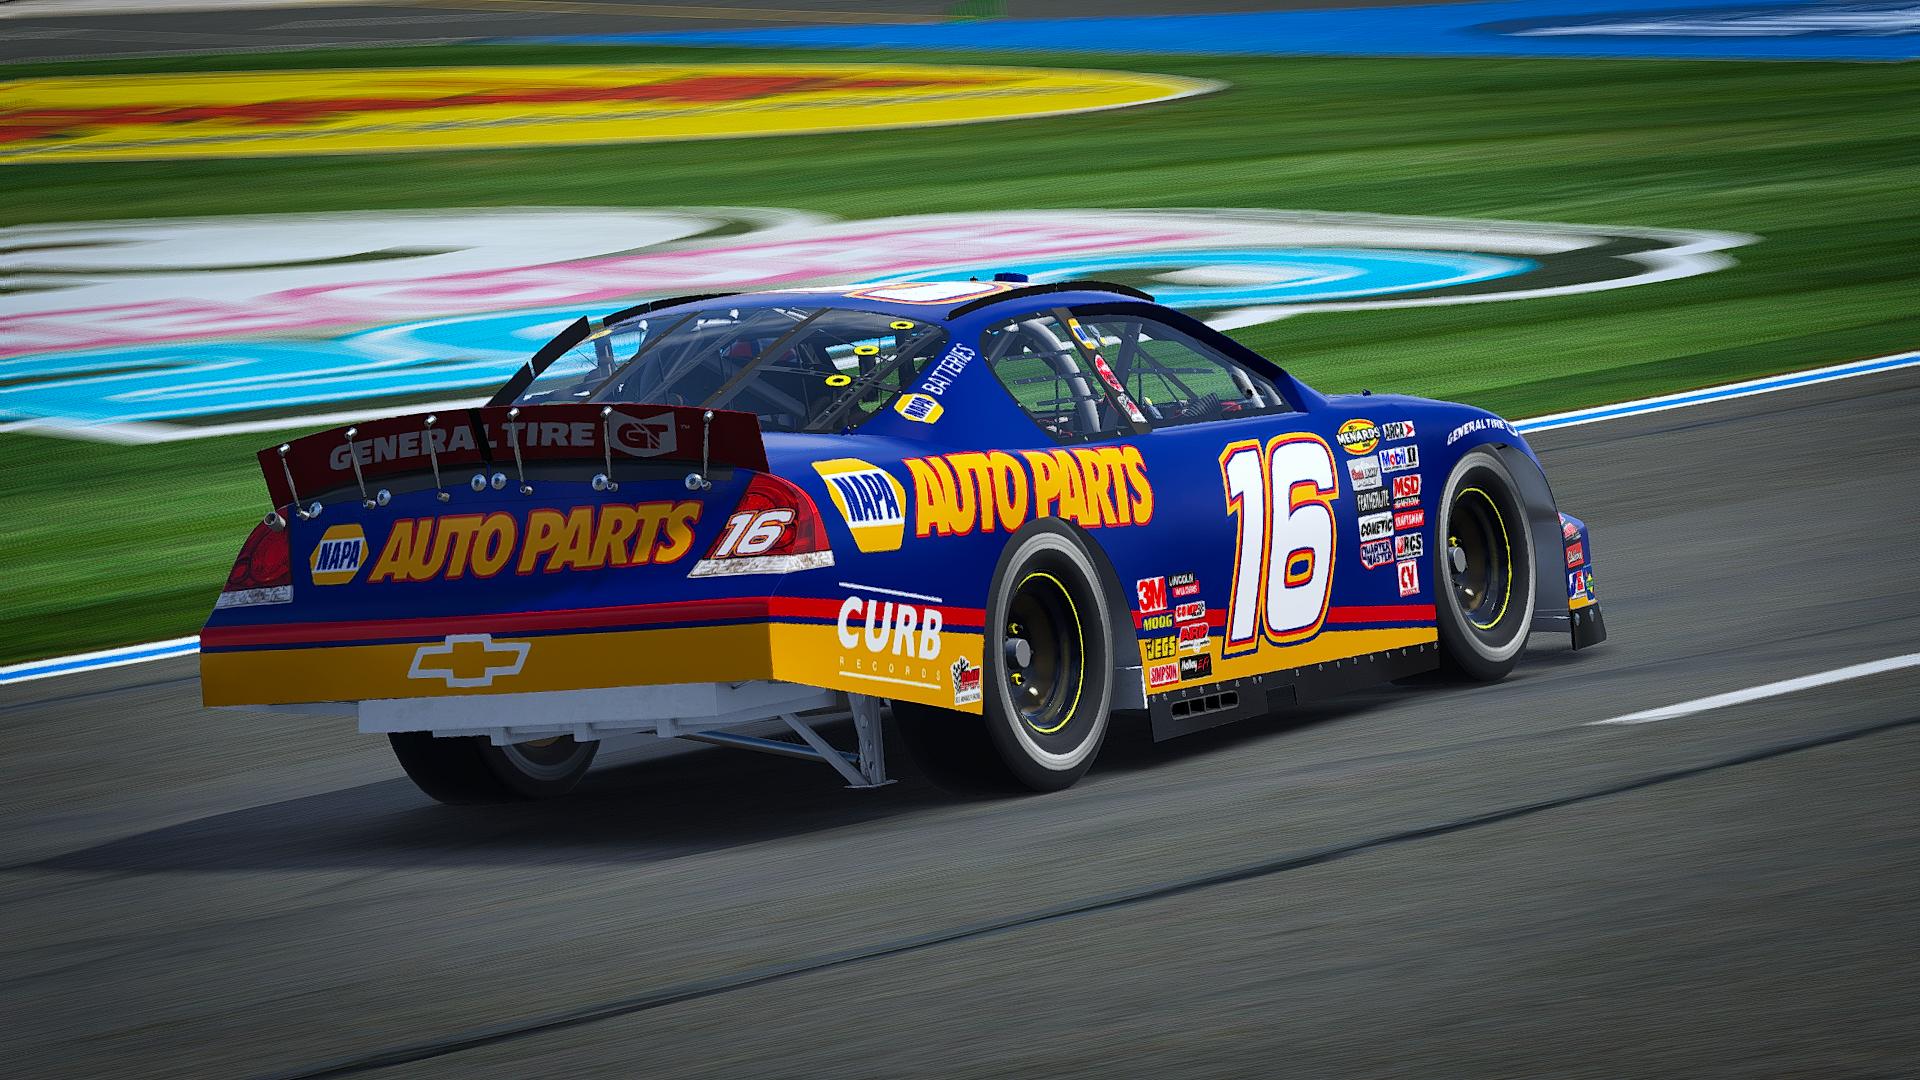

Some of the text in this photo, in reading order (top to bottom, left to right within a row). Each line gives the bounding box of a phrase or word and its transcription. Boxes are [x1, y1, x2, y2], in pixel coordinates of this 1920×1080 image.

[921, 343, 975, 395] BATTERIES
[904, 396, 935, 419] NAPA
[501, 421, 595, 448] TIRE
[1336, 427, 1381, 445] MENARDS
[1385, 423, 1405, 439] ARCA
[1447, 419, 1486, 446] GENERAL
[1381, 448, 1406, 467] Mobil
[832, 471, 901, 522] NAPA
[903, 445, 1154, 538] AUTO PARTS
[1393, 476, 1419, 497] MSD
[712, 507, 796, 558] 16
[1361, 519, 1392, 537] COMETIC
[367, 500, 703, 583] AUTO PARTS
[1219, 432, 1339, 659] 16
[317, 541, 361, 570] NAPA
[1169, 573, 1194, 586] LINCOLN
[1401, 565, 1415, 588] CV
[1138, 577, 1167, 611] 3M
[838, 596, 943, 661] CURB
[1143, 614, 1173, 631] MOOG
[1180, 624, 1209, 641] ARP
[1145, 635, 1177, 660] JEGS
[840, 656, 941, 681] RECORDS
[1150, 664, 1178, 684] SIMPSON
[1181, 659, 1198, 672] Holley
